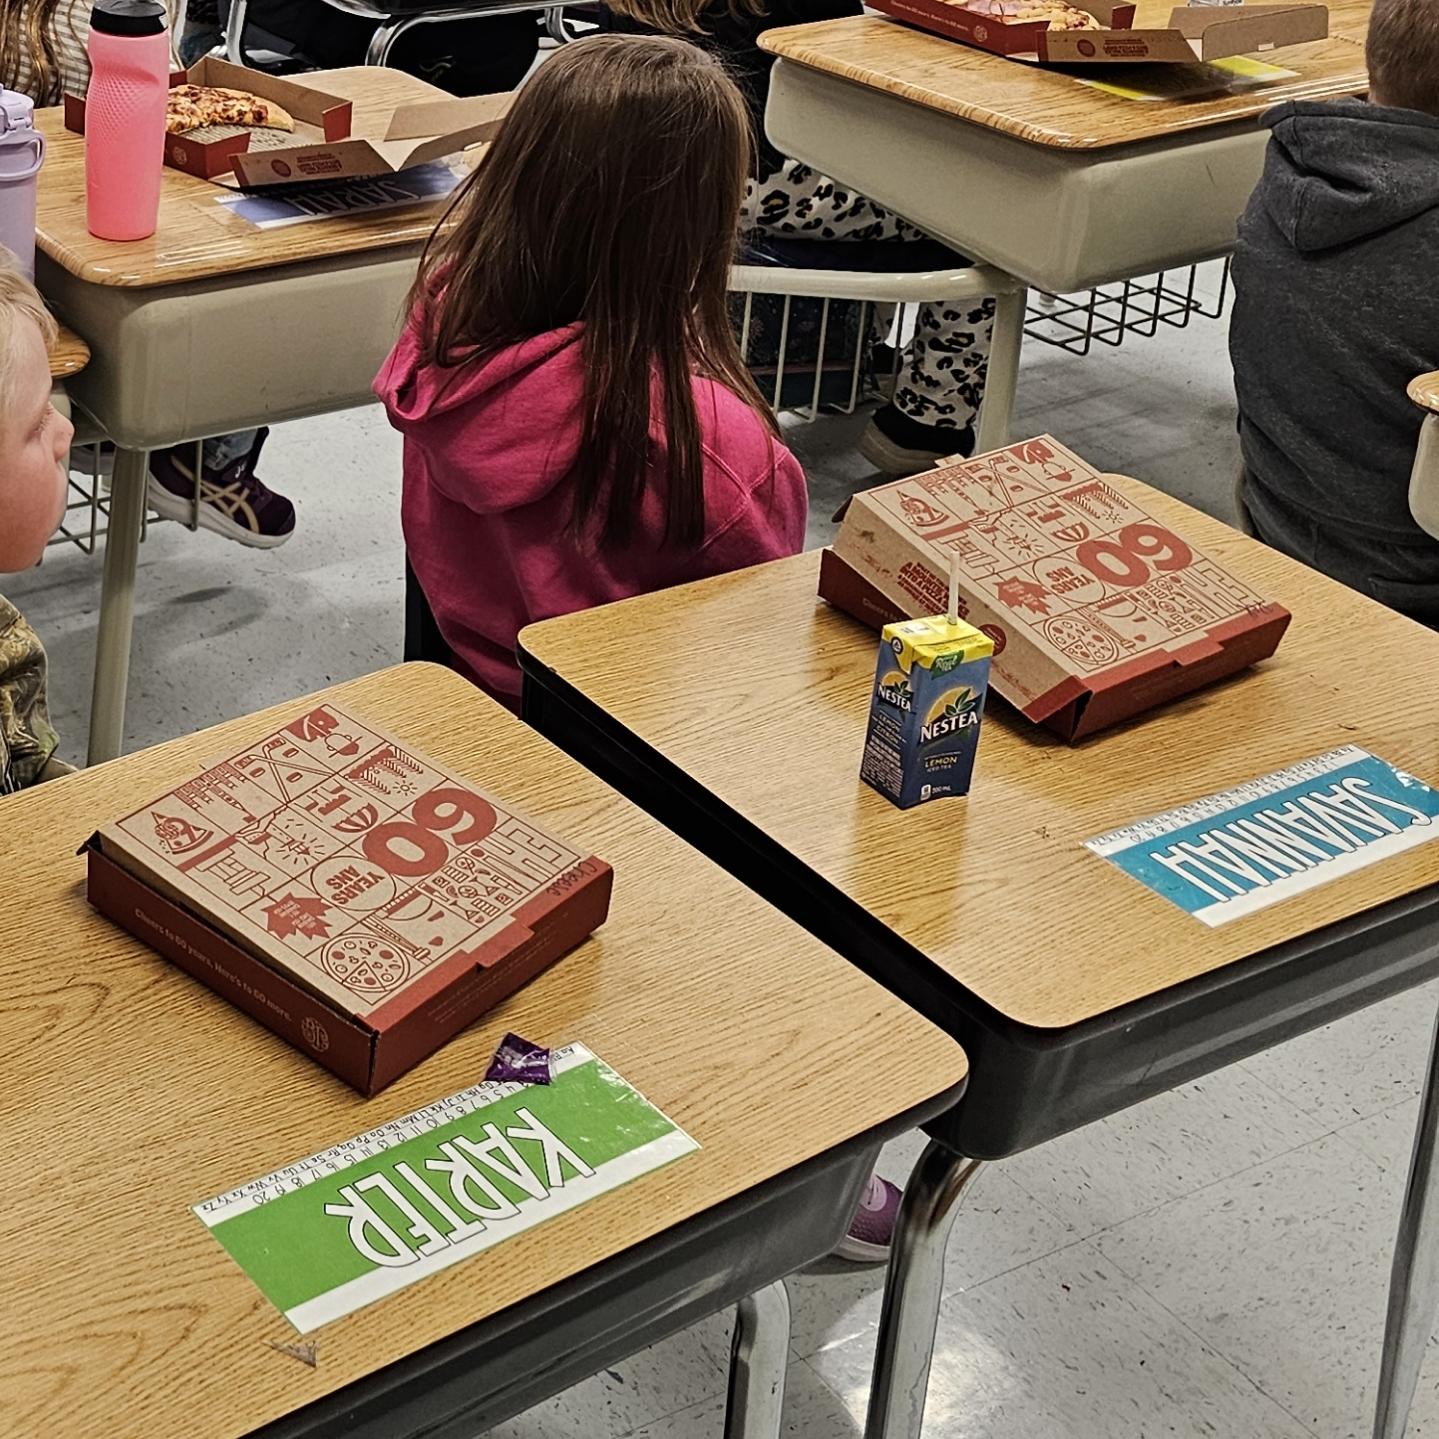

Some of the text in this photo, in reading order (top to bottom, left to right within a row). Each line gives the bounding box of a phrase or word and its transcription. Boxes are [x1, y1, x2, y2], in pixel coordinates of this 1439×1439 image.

[283, 180, 422, 216] SARAH
[1076, 523, 1193, 587] 60
[1045, 566, 1075, 582] ANS
[1052, 574, 1096, 594] YEARS
[877, 685, 911, 713] NESTEA
[920, 711, 978, 742] NESTEA
[925, 756, 958, 768] LEMON
[362, 787, 498, 878] 60
[1149, 777, 1433, 903] SAVANNAH
[325, 865, 362, 890] ANS
[331, 871, 386, 905] YEARS
[409, 1124, 422, 1136] 11
[424, 1116, 440, 1129] 10
[394, 1130, 408, 1142] 12
[359, 1145, 373, 1157] 14
[375, 1138, 391, 1150] 13
[342, 1152, 357, 1165] 15
[307, 1167, 322, 1180] 17
[324, 1160, 339, 1173] 16
[272, 1183, 286, 1195] 19
[289, 1175, 305, 1188] 18
[323, 1105, 596, 1268] KARTER
[250, 1190, 271, 1205] 20
